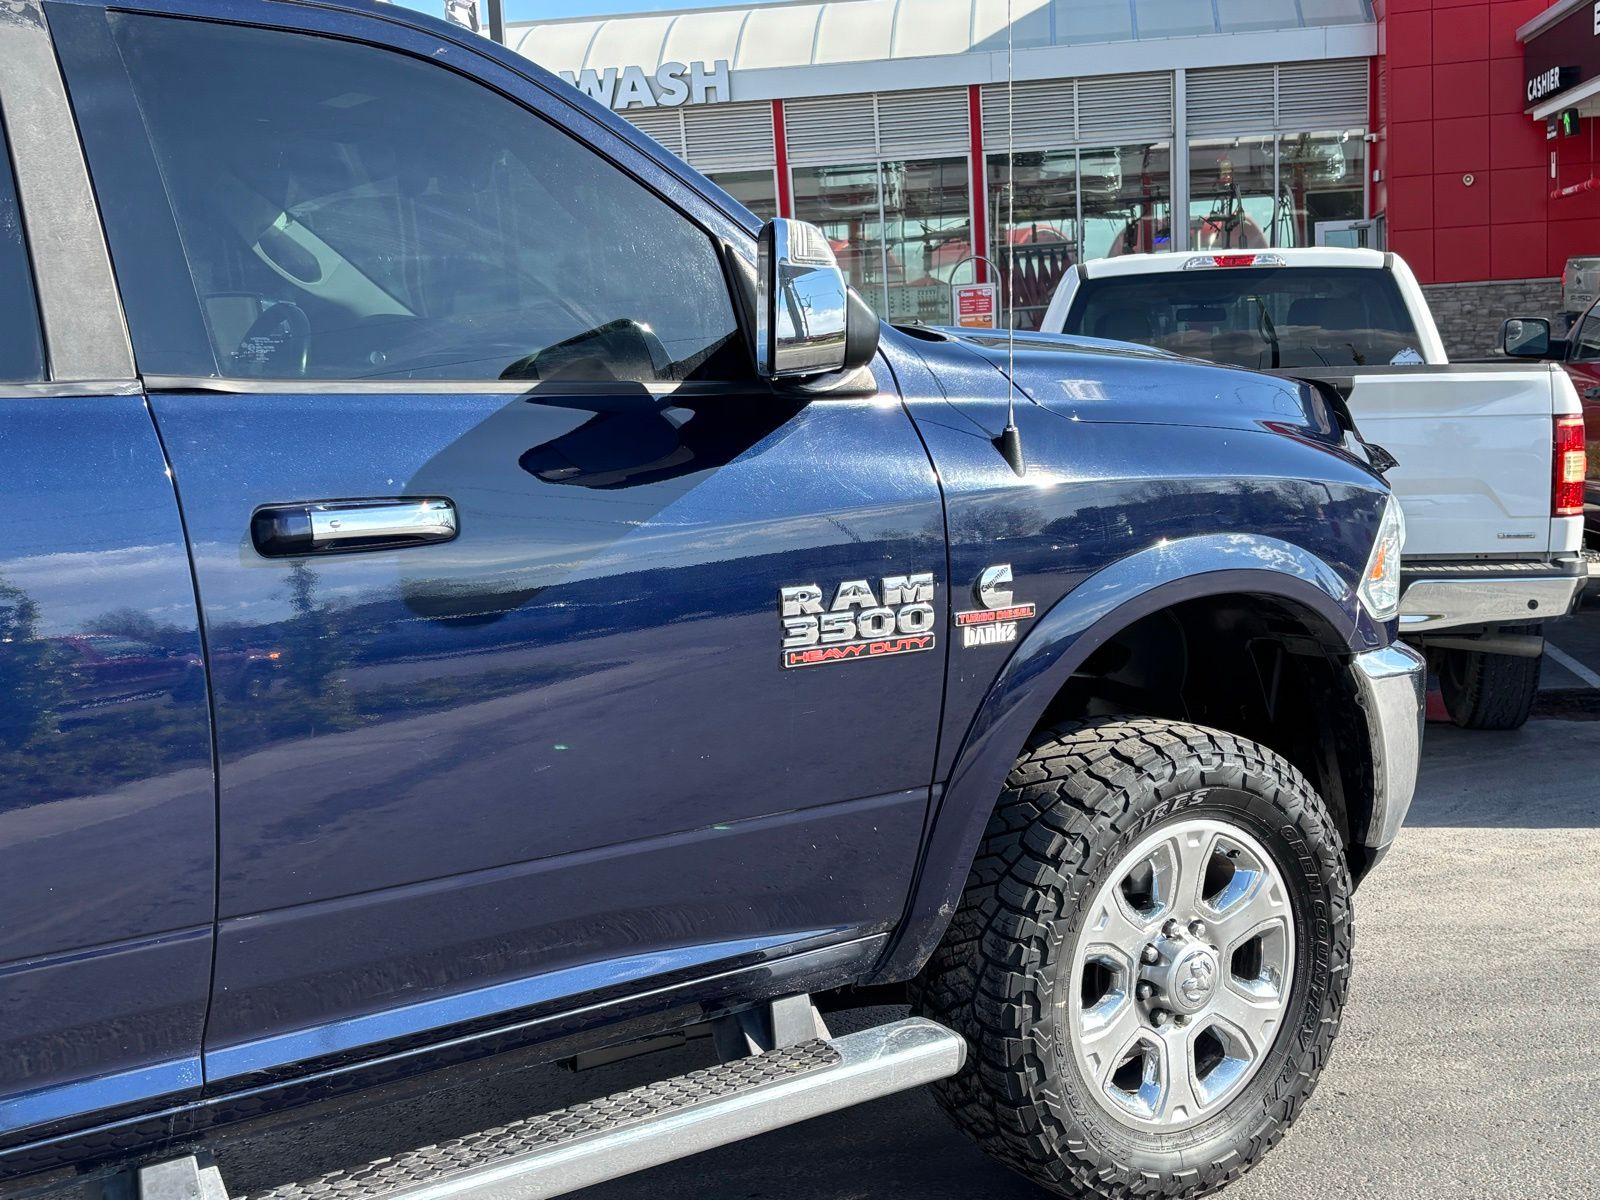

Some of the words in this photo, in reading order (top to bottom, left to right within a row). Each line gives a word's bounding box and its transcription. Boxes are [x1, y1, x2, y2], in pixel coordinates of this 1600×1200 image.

[558, 60, 731, 109] WASH
[1527, 66, 1560, 101] CASHIER
[778, 573, 934, 617] RAM
[980, 566, 1009, 593] Cummins
[781, 601, 935, 648] 3500
[958, 612, 995, 624] TURBO
[996, 607, 1034, 620] DIESEL
[790, 644, 867, 664] HEAVY
[869, 637, 931, 655] DUTY
[1122, 789, 1209, 843] TIRES
[1280, 824, 1322, 894] OPEN
[1299, 899, 1329, 1050] COUNTRY
